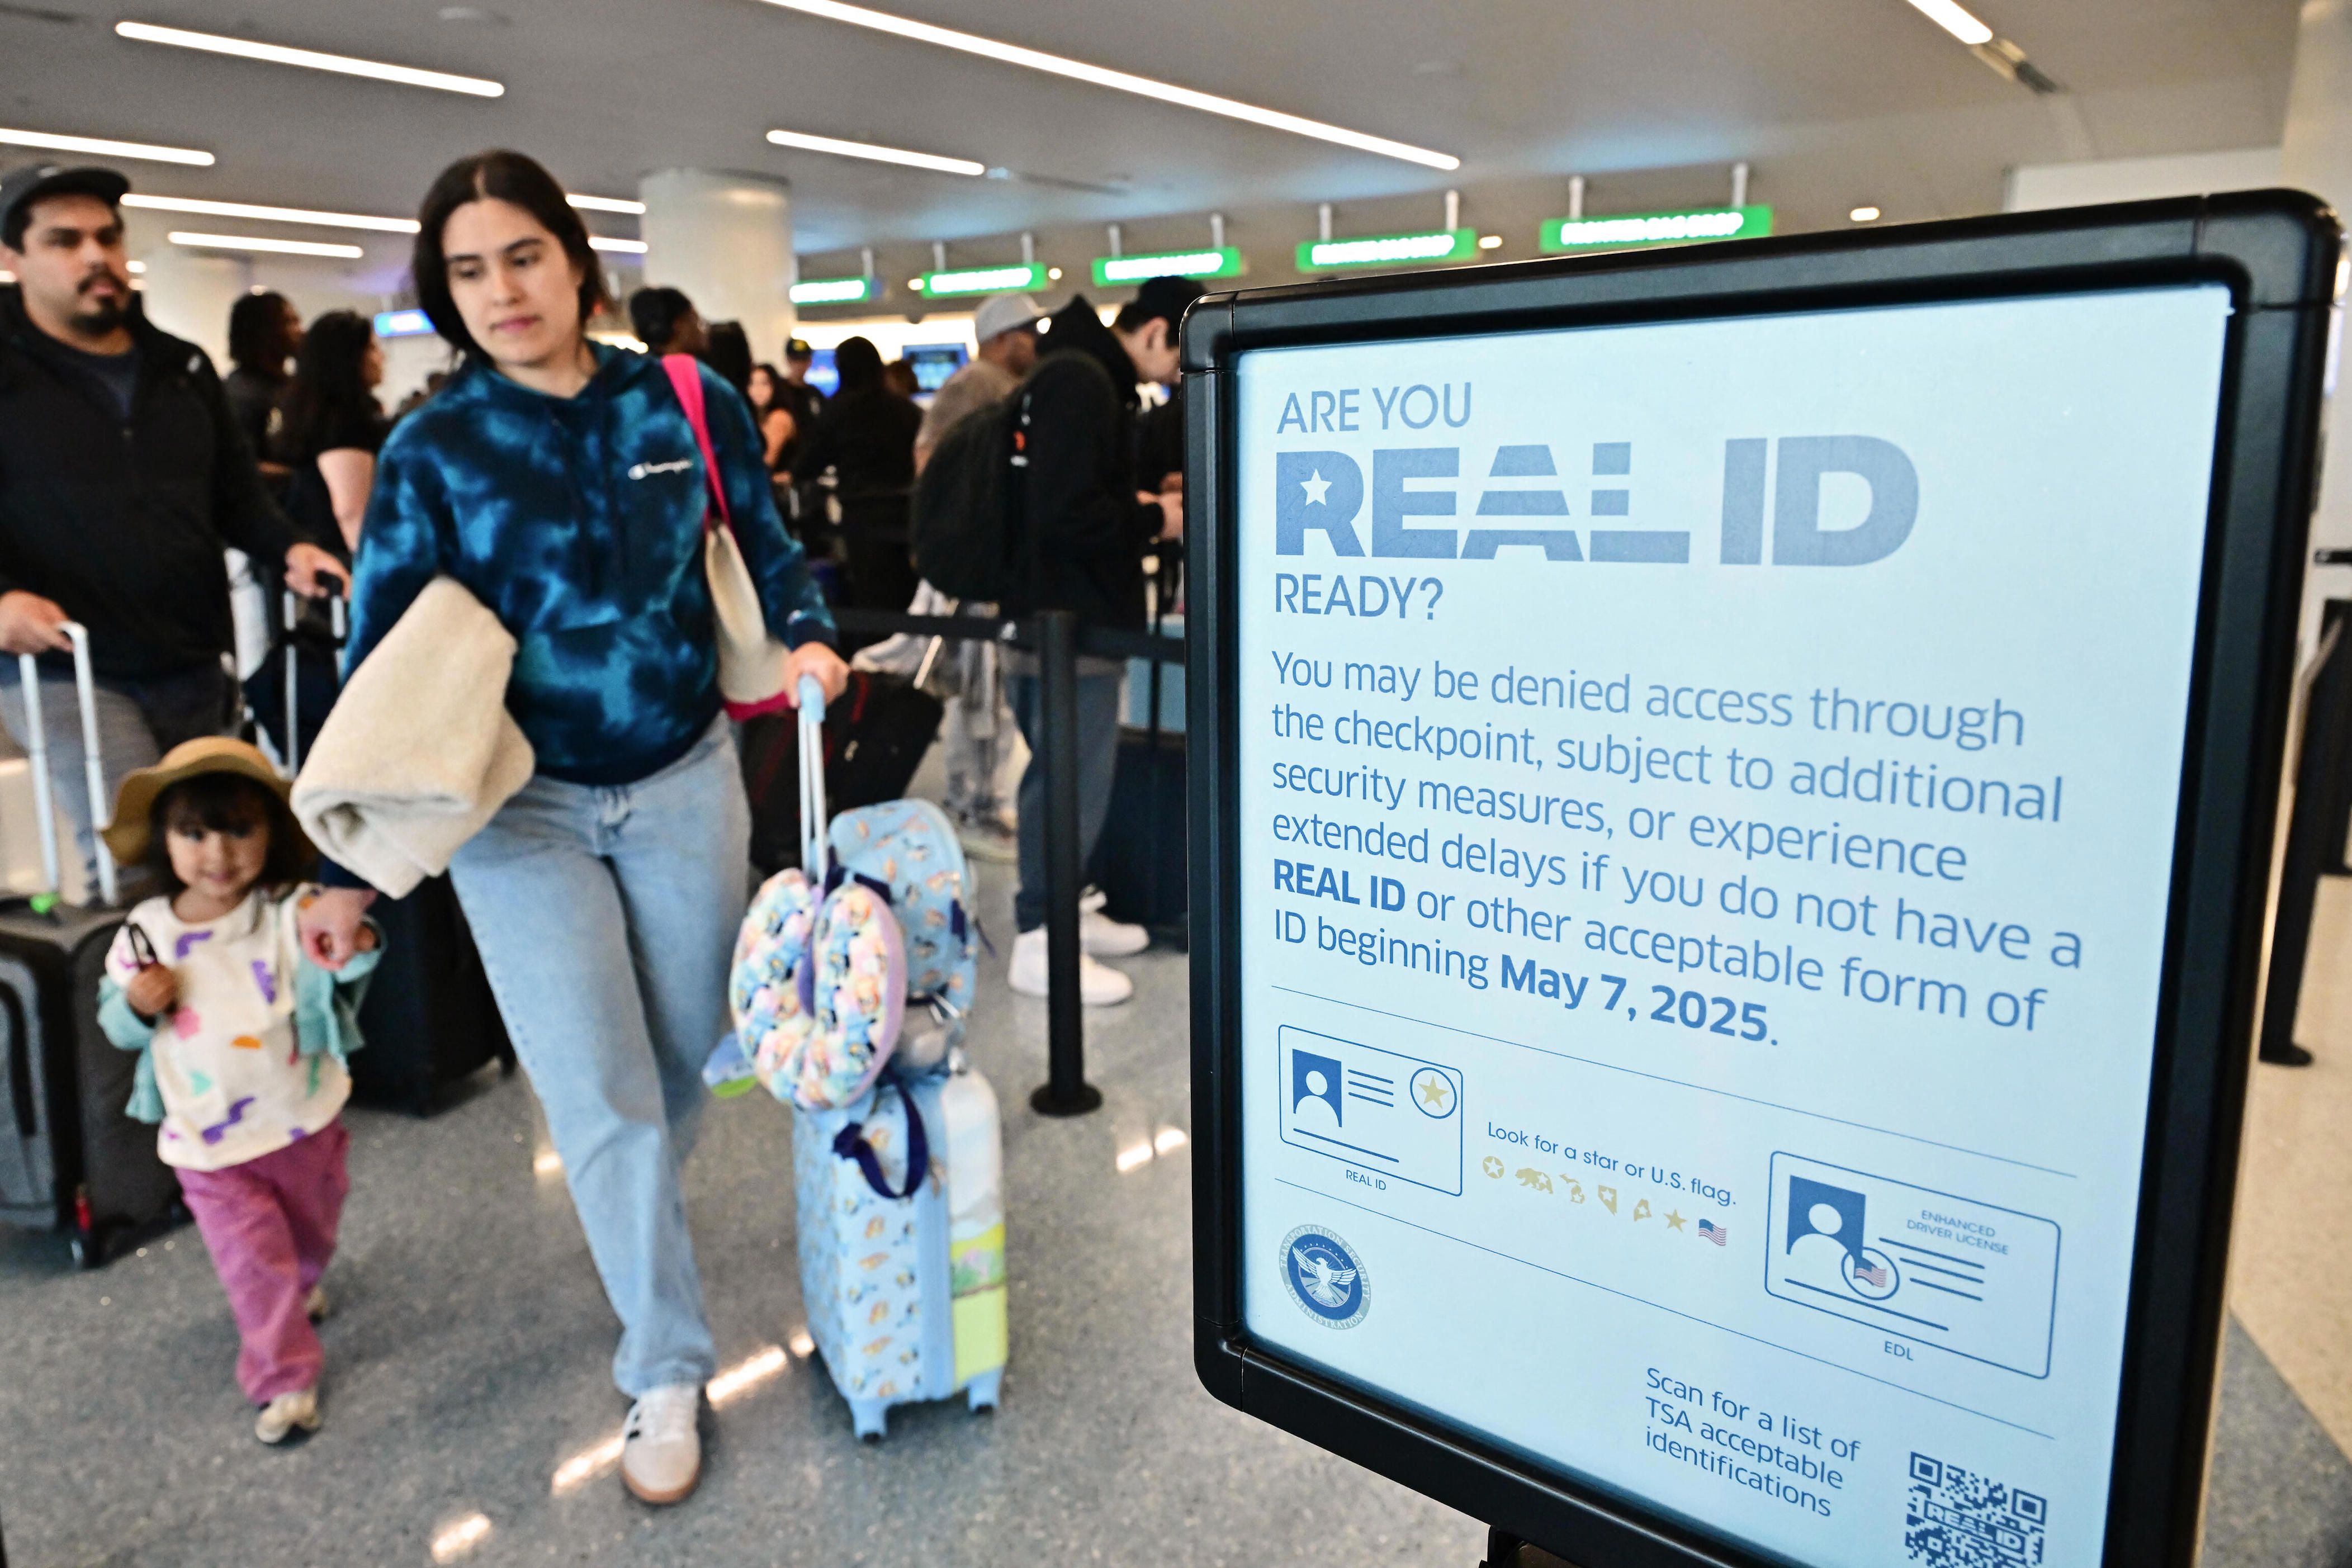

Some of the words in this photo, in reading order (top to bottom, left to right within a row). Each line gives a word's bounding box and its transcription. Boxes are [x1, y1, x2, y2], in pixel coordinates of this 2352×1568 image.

[1276, 387, 1360, 435] ARE
[1371, 381, 1473, 430] YOU
[1275, 441, 1691, 565] REAL
[1719, 434, 1920, 567] ID
[1275, 572, 1444, 620] READY?
[1271, 651, 1332, 688] You
[1345, 662, 1421, 702] may
[1434, 660, 1478, 700] be
[1491, 666, 1630, 713] denied
[1646, 685, 1793, 727] access
[1810, 688, 2024, 751] through
[1271, 703, 1324, 741] the
[1334, 709, 1542, 771] checkpoint,
[1557, 734, 1712, 785] subject
[1726, 748, 1773, 790] to
[1790, 756, 2063, 822] additional
[1273, 762, 1407, 811] security
[1419, 780, 1613, 840] measures,
[1629, 808, 1676, 841] or
[1690, 815, 1967, 882] experience
[1273, 813, 1428, 864] extended
[1442, 833, 1566, 888] delays
[1582, 851, 1610, 892] if
[1621, 866, 1703, 907] you
[1720, 875, 1778, 920] do
[1796, 893, 1878, 936] not
[1896, 897, 2031, 960] have
[2050, 931, 2082, 969] a
[1274, 858, 1360, 905] REAL
[1370, 875, 1405, 912] ID
[1417, 891, 1455, 921] or
[1467, 897, 1572, 943] other
[1584, 920, 1824, 991] acceptable
[1840, 956, 1967, 1019] form
[1986, 988, 2048, 1031] of
[1276, 909, 1306, 944] ID
[1318, 916, 1489, 990] beginning
[1501, 954, 1589, 1010] May
[1601, 973, 1636, 1021] 7,
[1650, 984, 1778, 1046] 2025.
[1346, 1169, 1373, 1187] REAL
[1375, 1179, 1386, 1190] ID
[1488, 1121, 1529, 1147] Look
[1534, 1135, 1559, 1154] for
[1564, 1147, 1577, 1160] a
[1583, 1150, 1619, 1171] star
[1625, 1163, 1645, 1178] or
[1651, 1166, 1686, 1191] U.S.
[1691, 1178, 1736, 1207] flag.
[1280, 1225, 1343, 1267] TRANSPORTATION
[1345, 1245, 1370, 1300] SECURITY
[1907, 1220, 1952, 1239] DRIVER
[1922, 1210, 1995, 1237] ENHANCED
[1285, 1284, 1364, 1329] ADMINISTRATION
[1884, 1340, 1914, 1361] EDL
[1645, 1367, 1703, 1406] Scan
[1712, 1391, 1750, 1421] for
[1758, 1412, 1773, 1432] a
[1783, 1415, 1823, 1450] list
[1830, 1438, 1861, 1462] of
[1645, 1396, 1692, 1433] TSA
[1700, 1422, 1843, 1490] acceptable
[1645, 1428, 1832, 1517] identifications
[1927, 1504, 1994, 1541] REAL
[1995, 1528, 2022, 1550] ID
